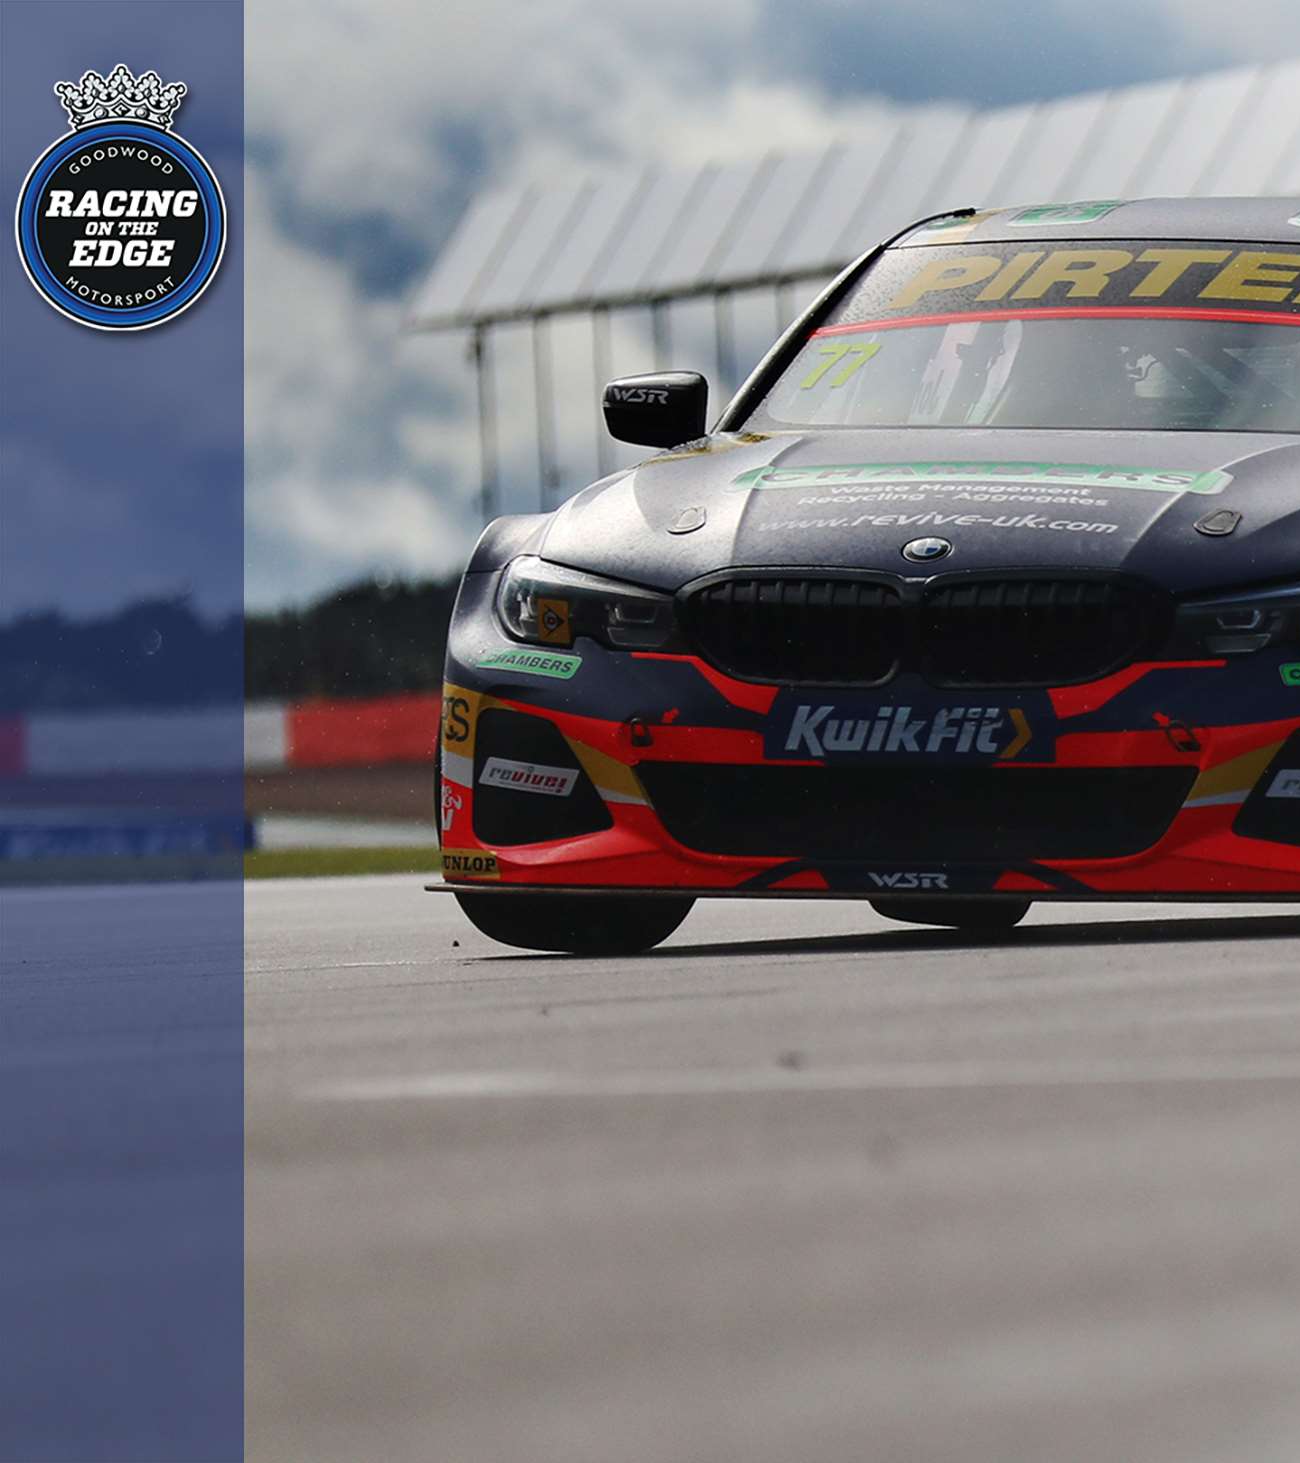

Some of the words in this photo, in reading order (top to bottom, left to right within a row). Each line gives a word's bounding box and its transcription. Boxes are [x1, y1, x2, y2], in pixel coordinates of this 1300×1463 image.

[800, 342, 881, 390] 77
[613, 388, 669, 404] WSR
[831, 484, 910, 494] Waste
[918, 483, 1091, 496] Management
[798, 492, 927, 504] Recycling
[949, 492, 1109, 507] Aggregates
[442, 855, 496, 872] UNLOP
[868, 872, 949, 889] WSR
